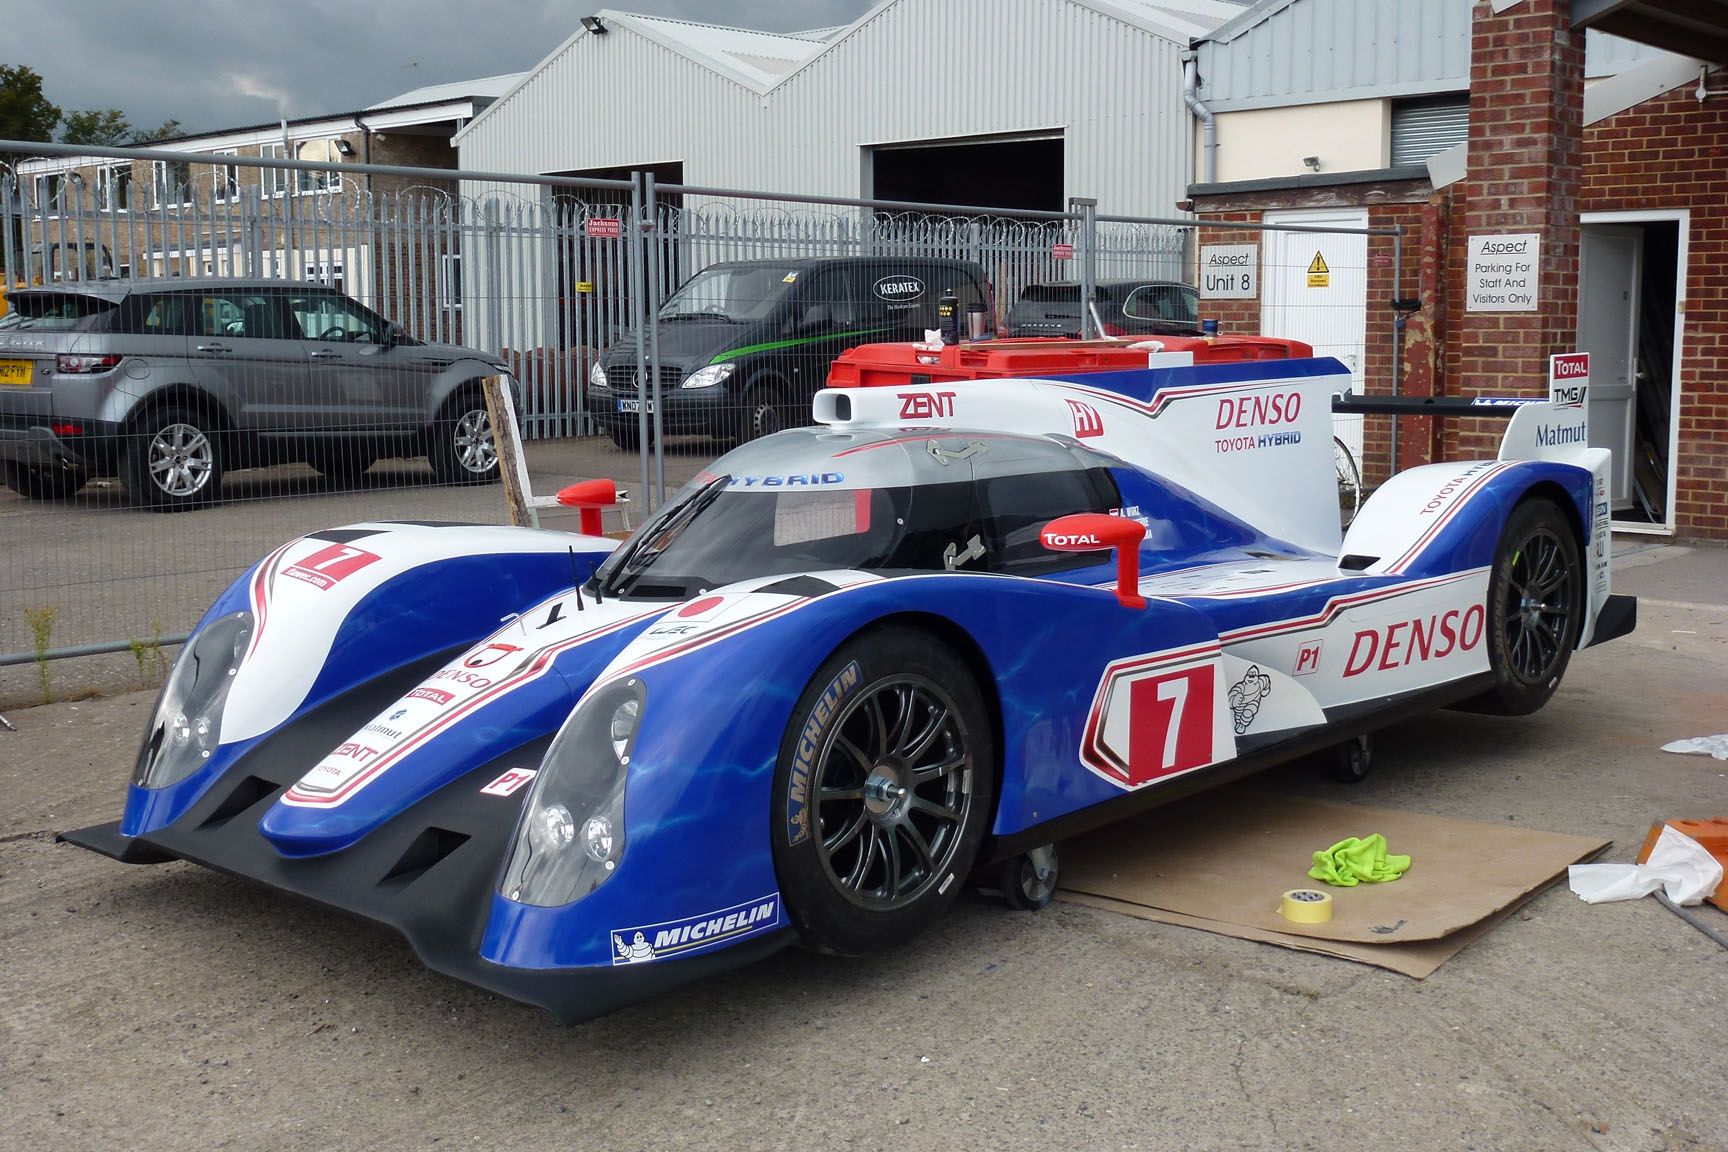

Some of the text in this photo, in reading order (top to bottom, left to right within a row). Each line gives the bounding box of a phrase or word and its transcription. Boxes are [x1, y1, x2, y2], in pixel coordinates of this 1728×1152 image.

[588, 219, 618, 227] Jacksons
[1481, 240, 1528, 255] Aspect
[1209, 253, 1249, 267] Aspect
[1475, 262, 1531, 275] Parking For
[880, 281, 920, 295] KERATEX
[1206, 273, 1250, 291] Unit 8
[1479, 277, 1526, 289] Staff And
[1472, 293, 1532, 305] Visitors Only
[1555, 360, 1587, 375] TOTAL
[896, 391, 957, 420] ZENT
[1215, 392, 1302, 430] DENSO
[1215, 431, 1302, 453] TOYOTA HYBRID
[1536, 421, 1586, 447] Matmut
[1420, 477, 1468, 515] TOYOTA
[1044, 532, 1100, 546] TOTAL
[313, 547, 365, 571] 7
[649, 625, 699, 635] WEC
[1342, 603, 1485, 678] DENSO
[1297, 645, 1320, 672] P1
[1157, 676, 1189, 769] 7
[790, 664, 857, 804] MICHELIN
[489, 772, 531, 791] P1
[653, 901, 775, 948] MICHELIN
